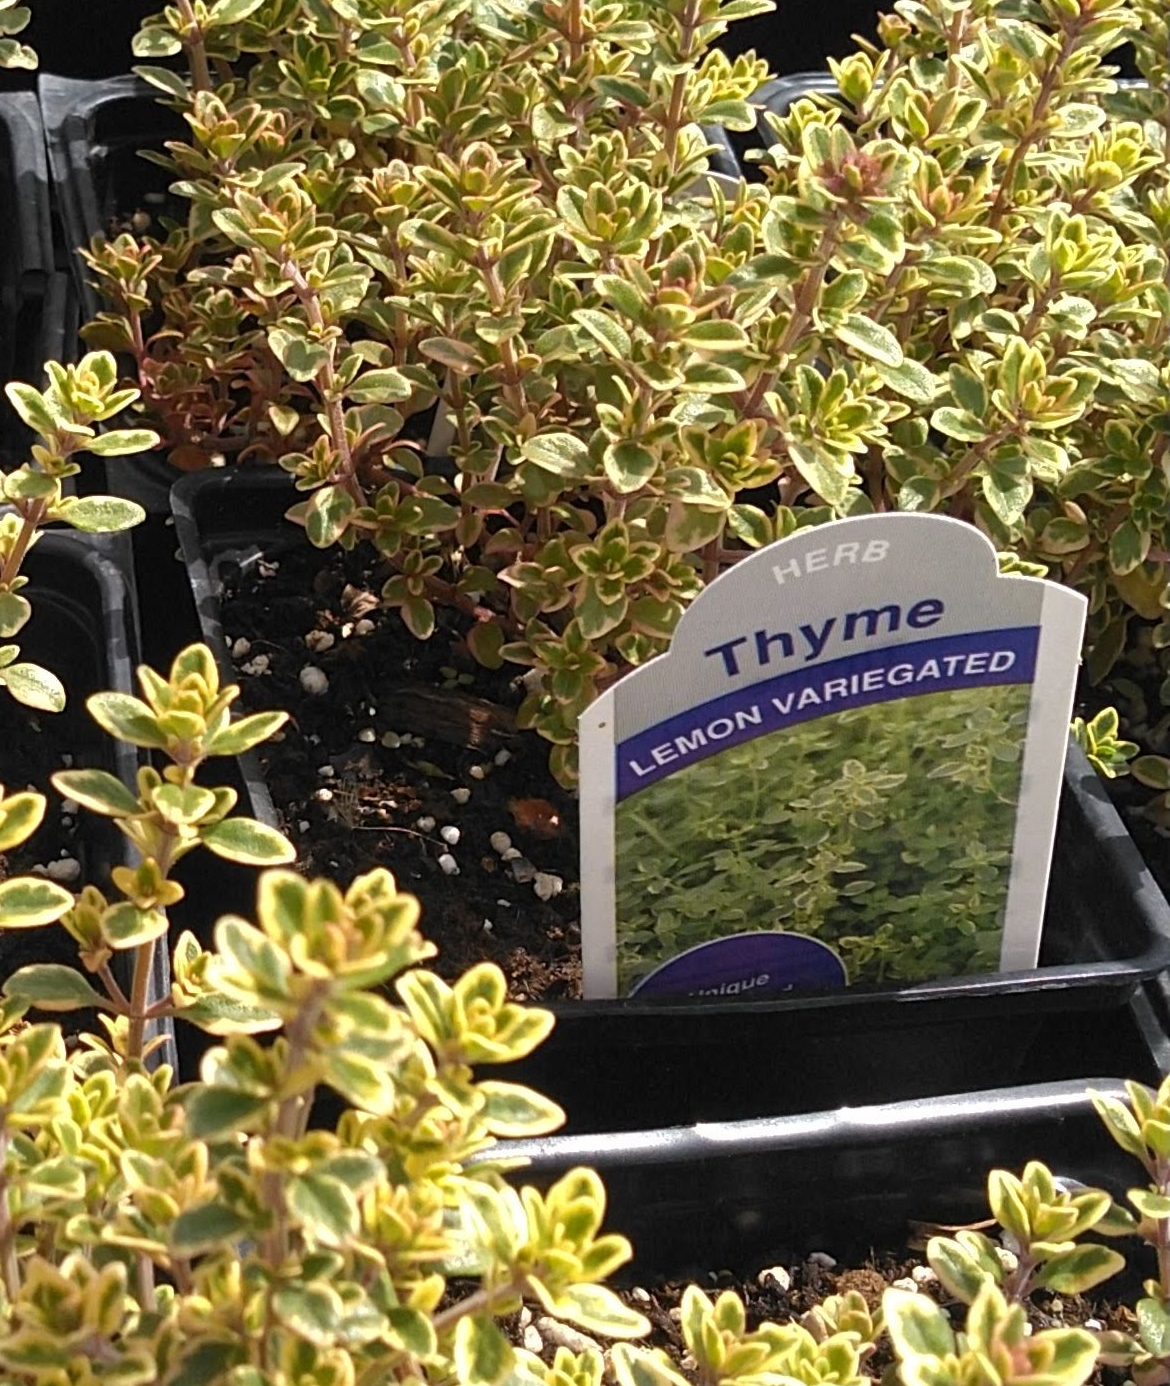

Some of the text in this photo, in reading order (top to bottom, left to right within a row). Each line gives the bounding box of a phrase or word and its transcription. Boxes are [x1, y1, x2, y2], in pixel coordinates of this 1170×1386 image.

[771, 539, 891, 585] HERB
[703, 596, 946, 678] Thyme
[629, 648, 1017, 779] LEMON VARIEGATED
